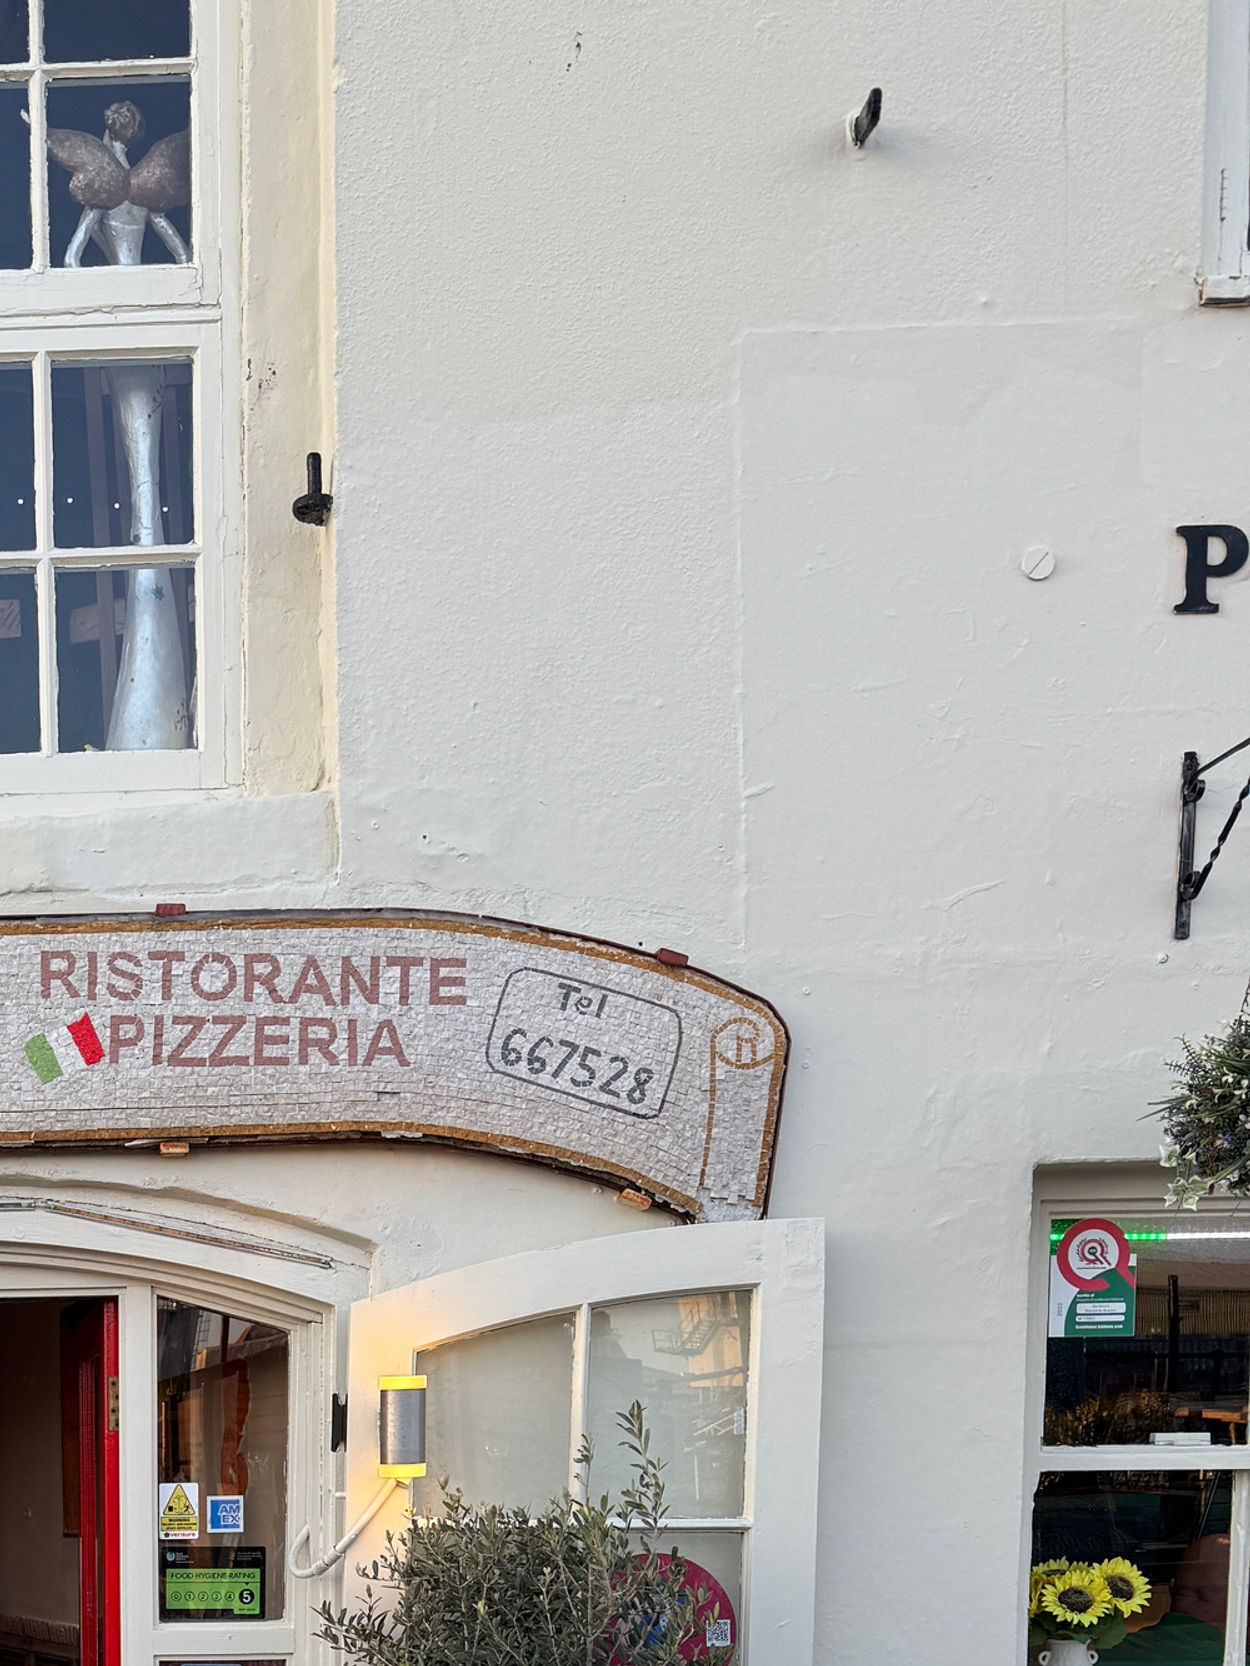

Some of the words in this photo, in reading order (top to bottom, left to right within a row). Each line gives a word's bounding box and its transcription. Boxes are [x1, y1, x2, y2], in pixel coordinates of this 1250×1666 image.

[40, 950, 468, 1006] RISTORANTE
[557, 982, 608, 1018] Tel
[108, 1014, 411, 1068] PIZZERIA
[501, 1027, 655, 1105] 667528
[171, 1572, 194, 1580] FOOD
[195, 1572, 228, 1580] HYGIENE
[228, 1572, 256, 1580] RATING
